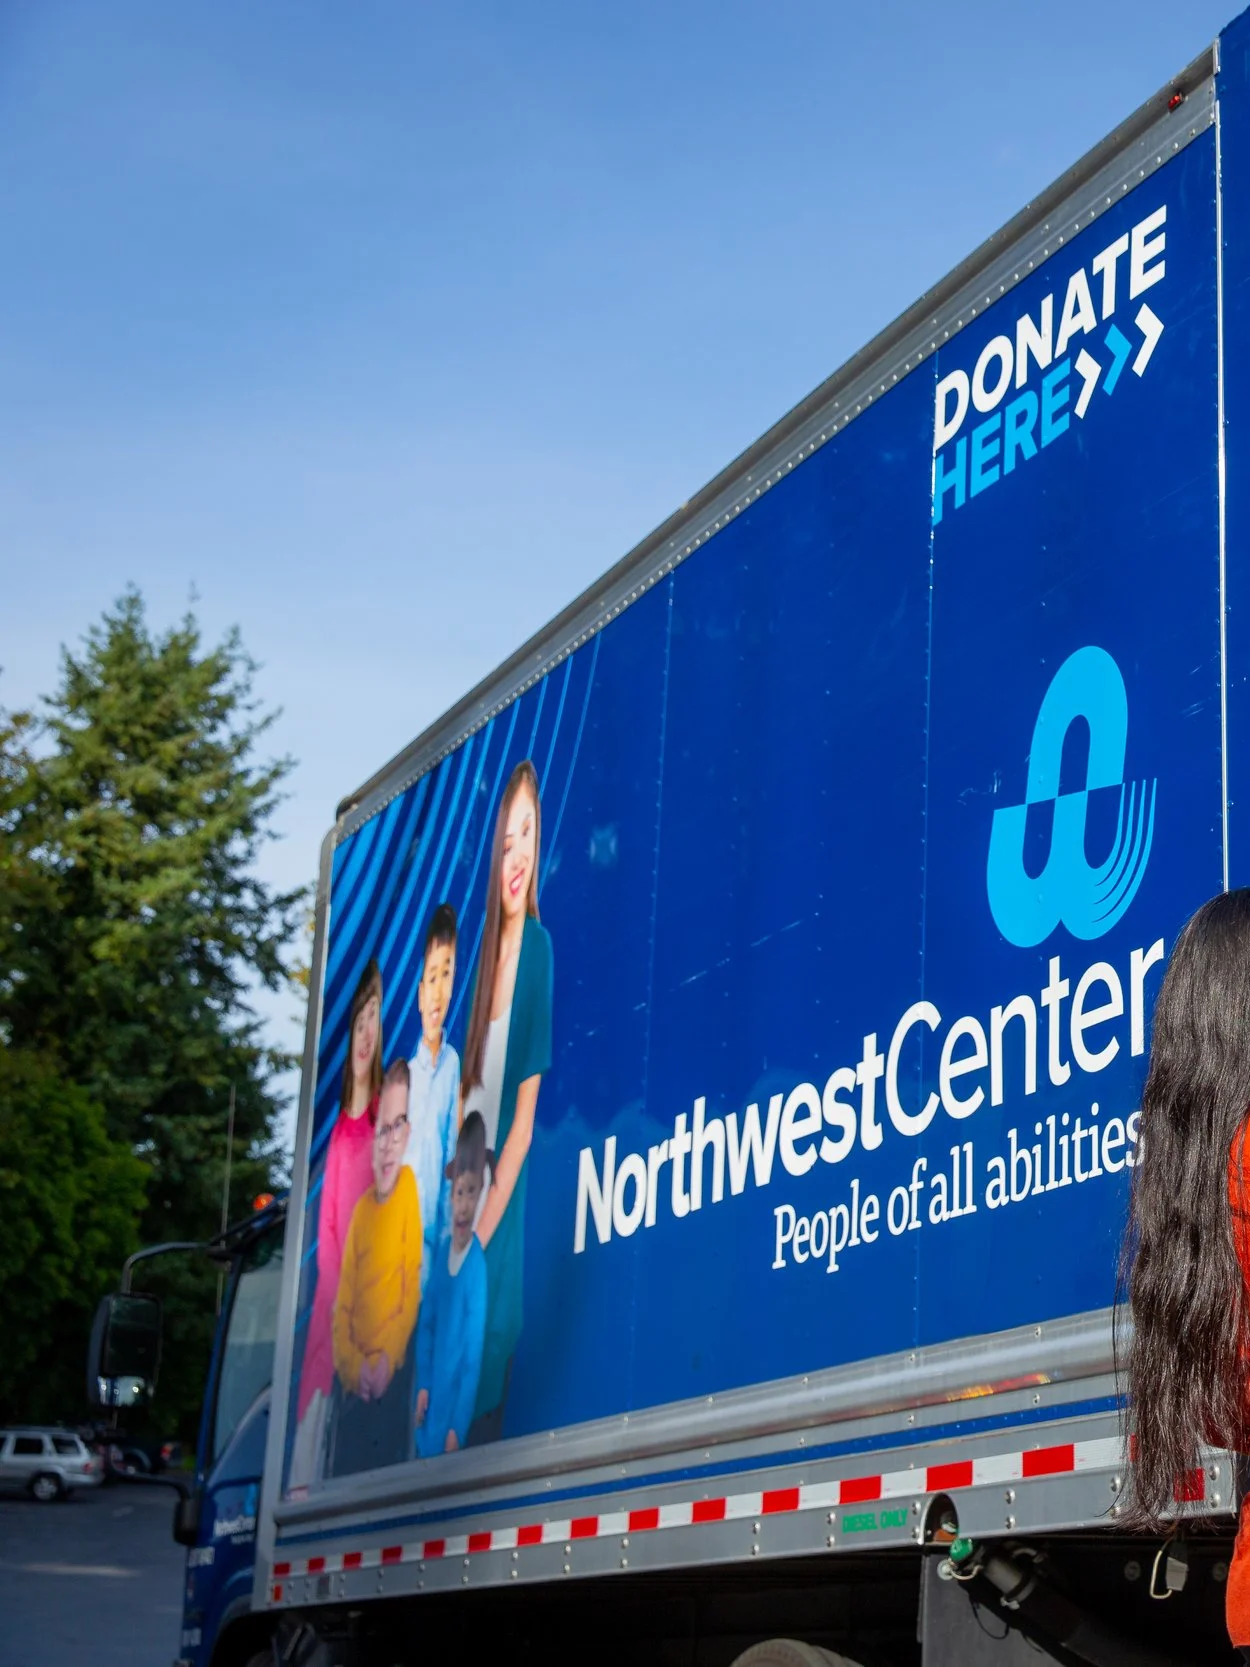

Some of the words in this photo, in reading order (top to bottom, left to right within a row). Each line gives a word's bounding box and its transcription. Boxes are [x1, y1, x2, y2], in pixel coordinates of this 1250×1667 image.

[934, 204, 1167, 452] DONATE
[932, 357, 1071, 527] HERE
[574, 938, 1165, 1255] NorthwestCenter
[772, 1178, 880, 1274] People
[887, 1157, 928, 1237] of
[928, 1141, 974, 1225] all
[986, 1103, 1145, 1209] abilities
[842, 1513, 877, 1533] DIESEL
[880, 1509, 908, 1529] ONLY
